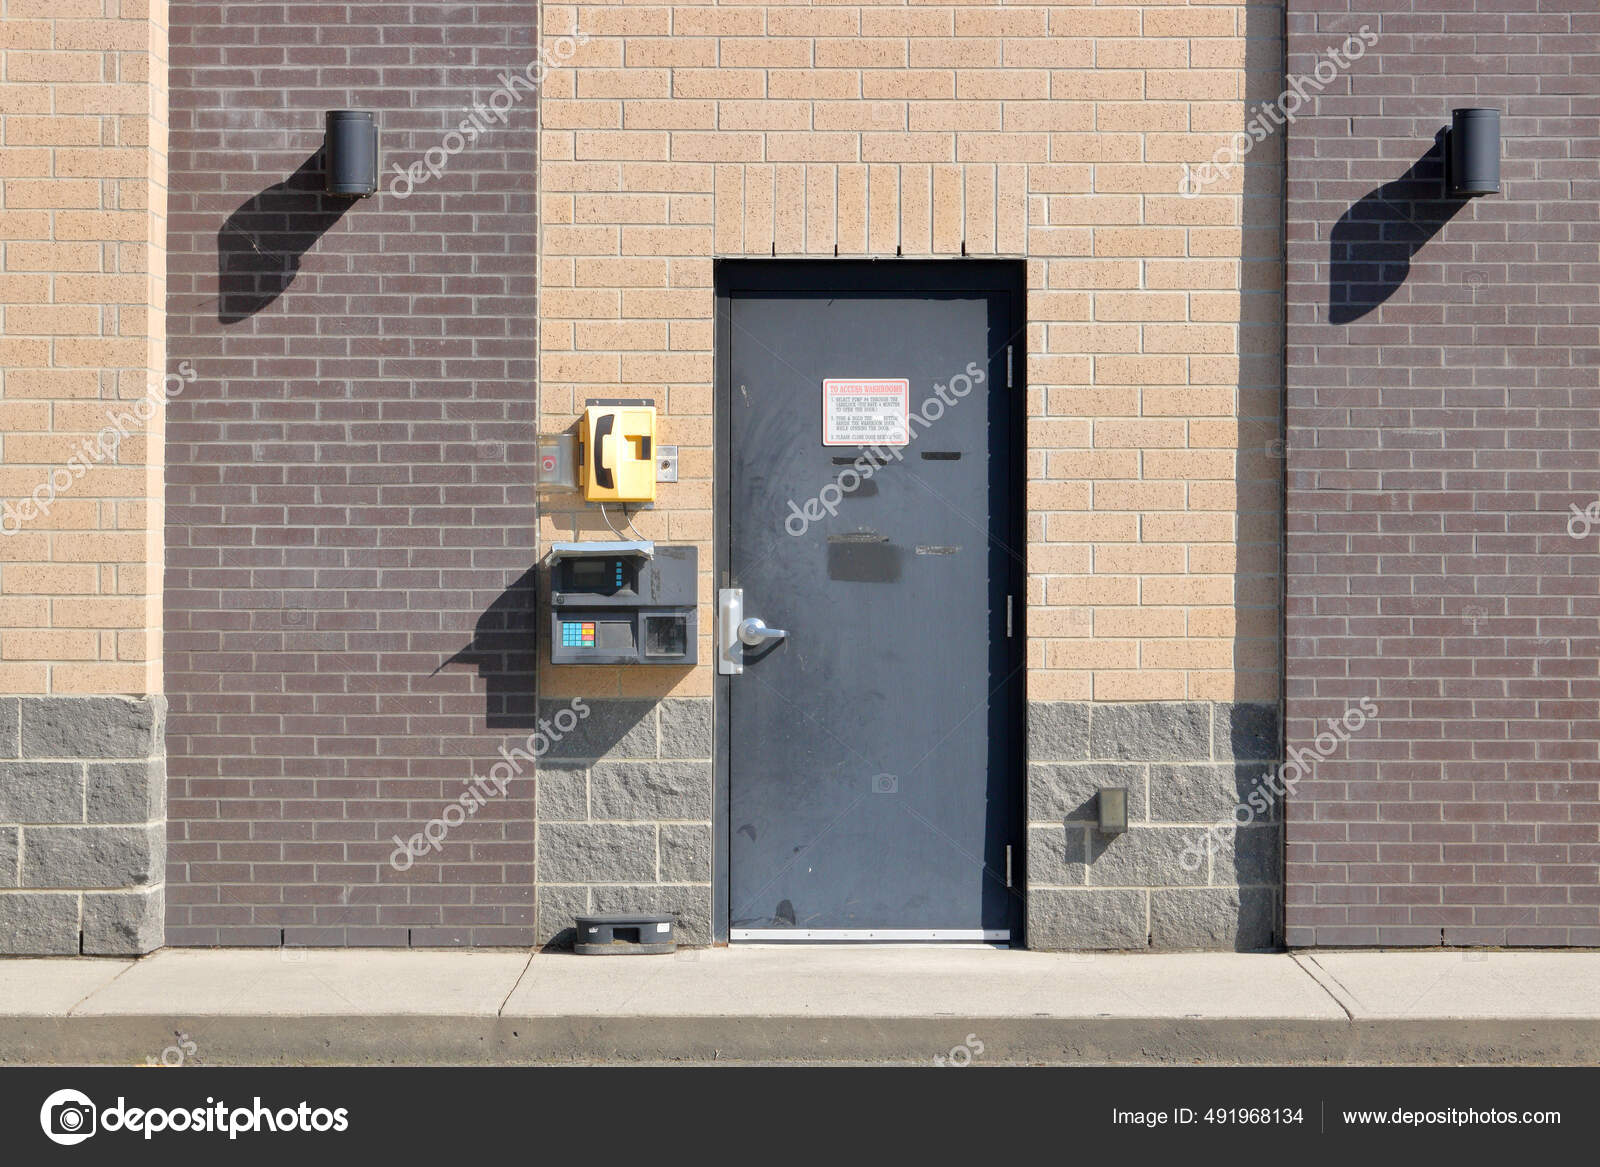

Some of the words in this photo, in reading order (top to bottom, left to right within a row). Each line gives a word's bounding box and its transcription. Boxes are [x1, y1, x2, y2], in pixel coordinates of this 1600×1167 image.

[830, 385, 839, 393] TO
[840, 385, 863, 393] ACCESS
[864, 385, 903, 393] WASHROOMS
